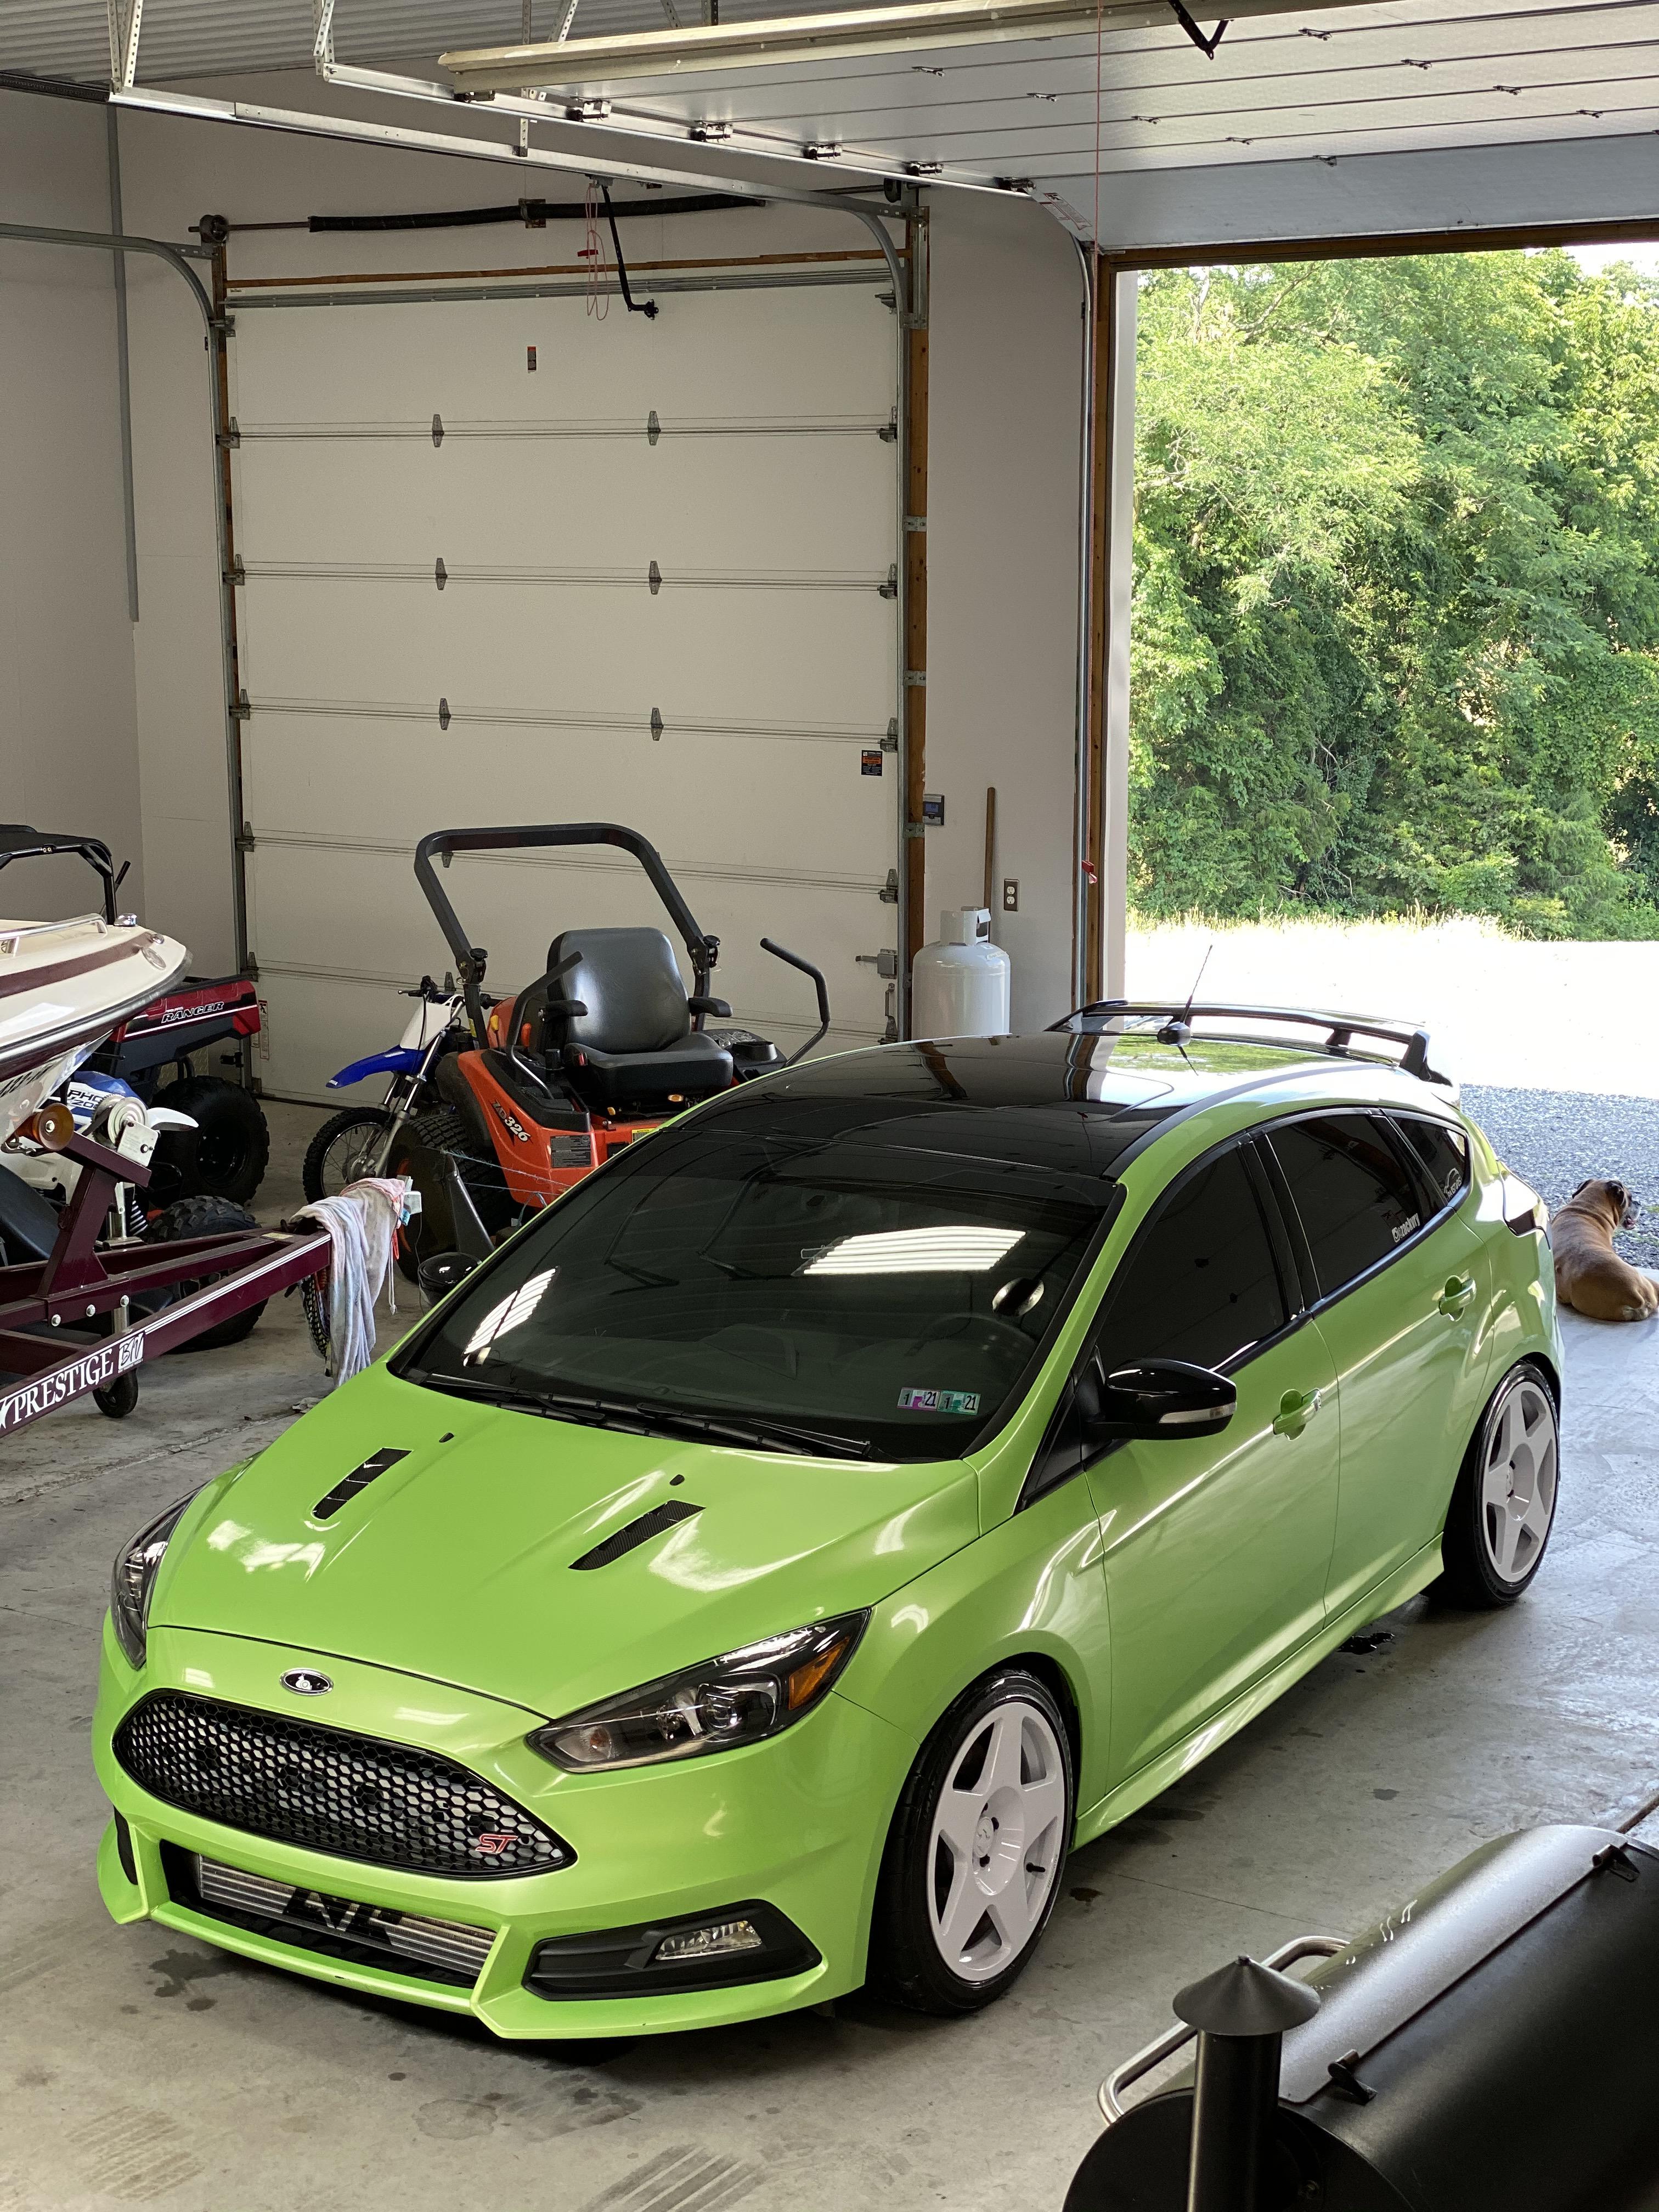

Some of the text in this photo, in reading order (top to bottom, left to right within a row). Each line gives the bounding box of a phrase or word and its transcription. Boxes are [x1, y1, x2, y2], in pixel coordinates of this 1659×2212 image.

[161, 1001, 224, 1024] RANGER
[71, 1099, 98, 1109] 20
[9, 1348, 114, 1425] PRESTIGE
[905, 1392, 936, 1407] 1 21
[945, 1395, 976, 1410] 1 21
[475, 1833, 518, 1854] ST
